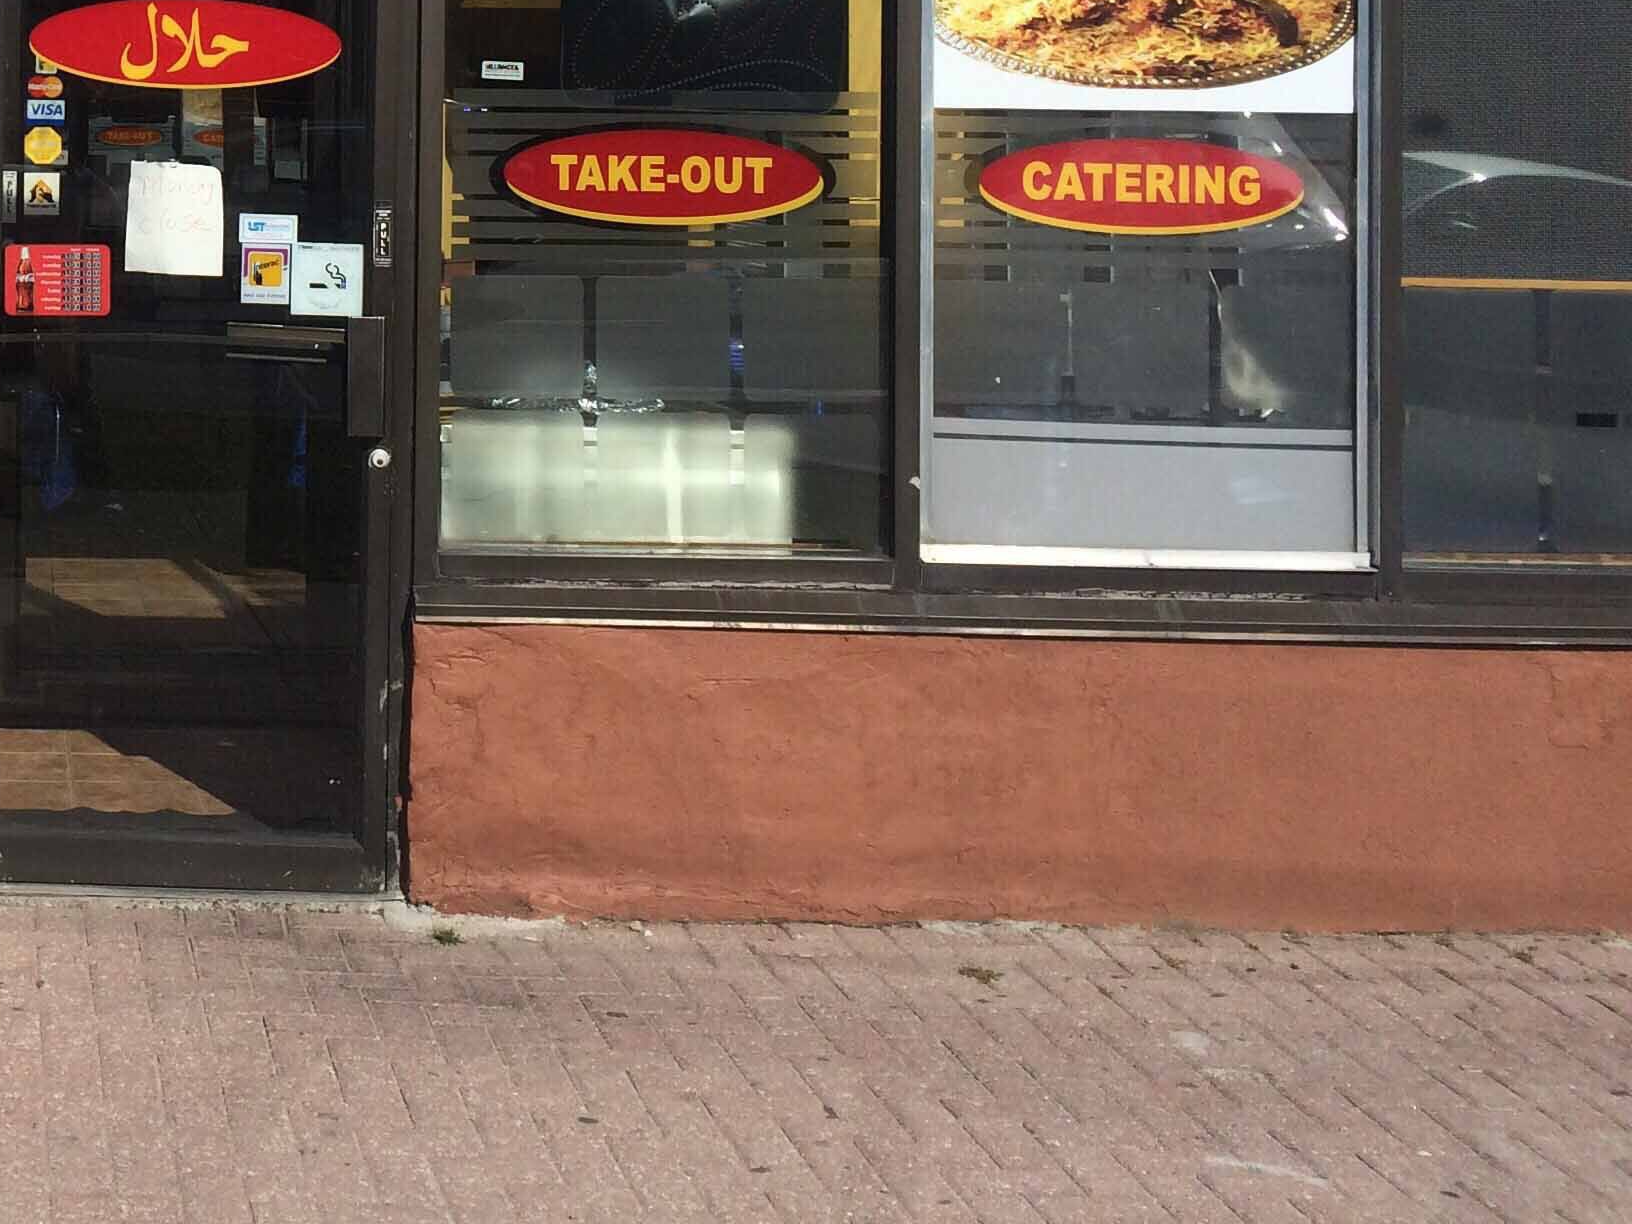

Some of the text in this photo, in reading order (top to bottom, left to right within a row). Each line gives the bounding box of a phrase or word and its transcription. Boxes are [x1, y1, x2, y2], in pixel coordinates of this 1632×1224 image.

[120, 2, 249, 80] حلال
[31, 103, 63, 116] VISA
[550, 154, 773, 194] TAKE-OUT
[1022, 161, 1261, 206] CATERING
